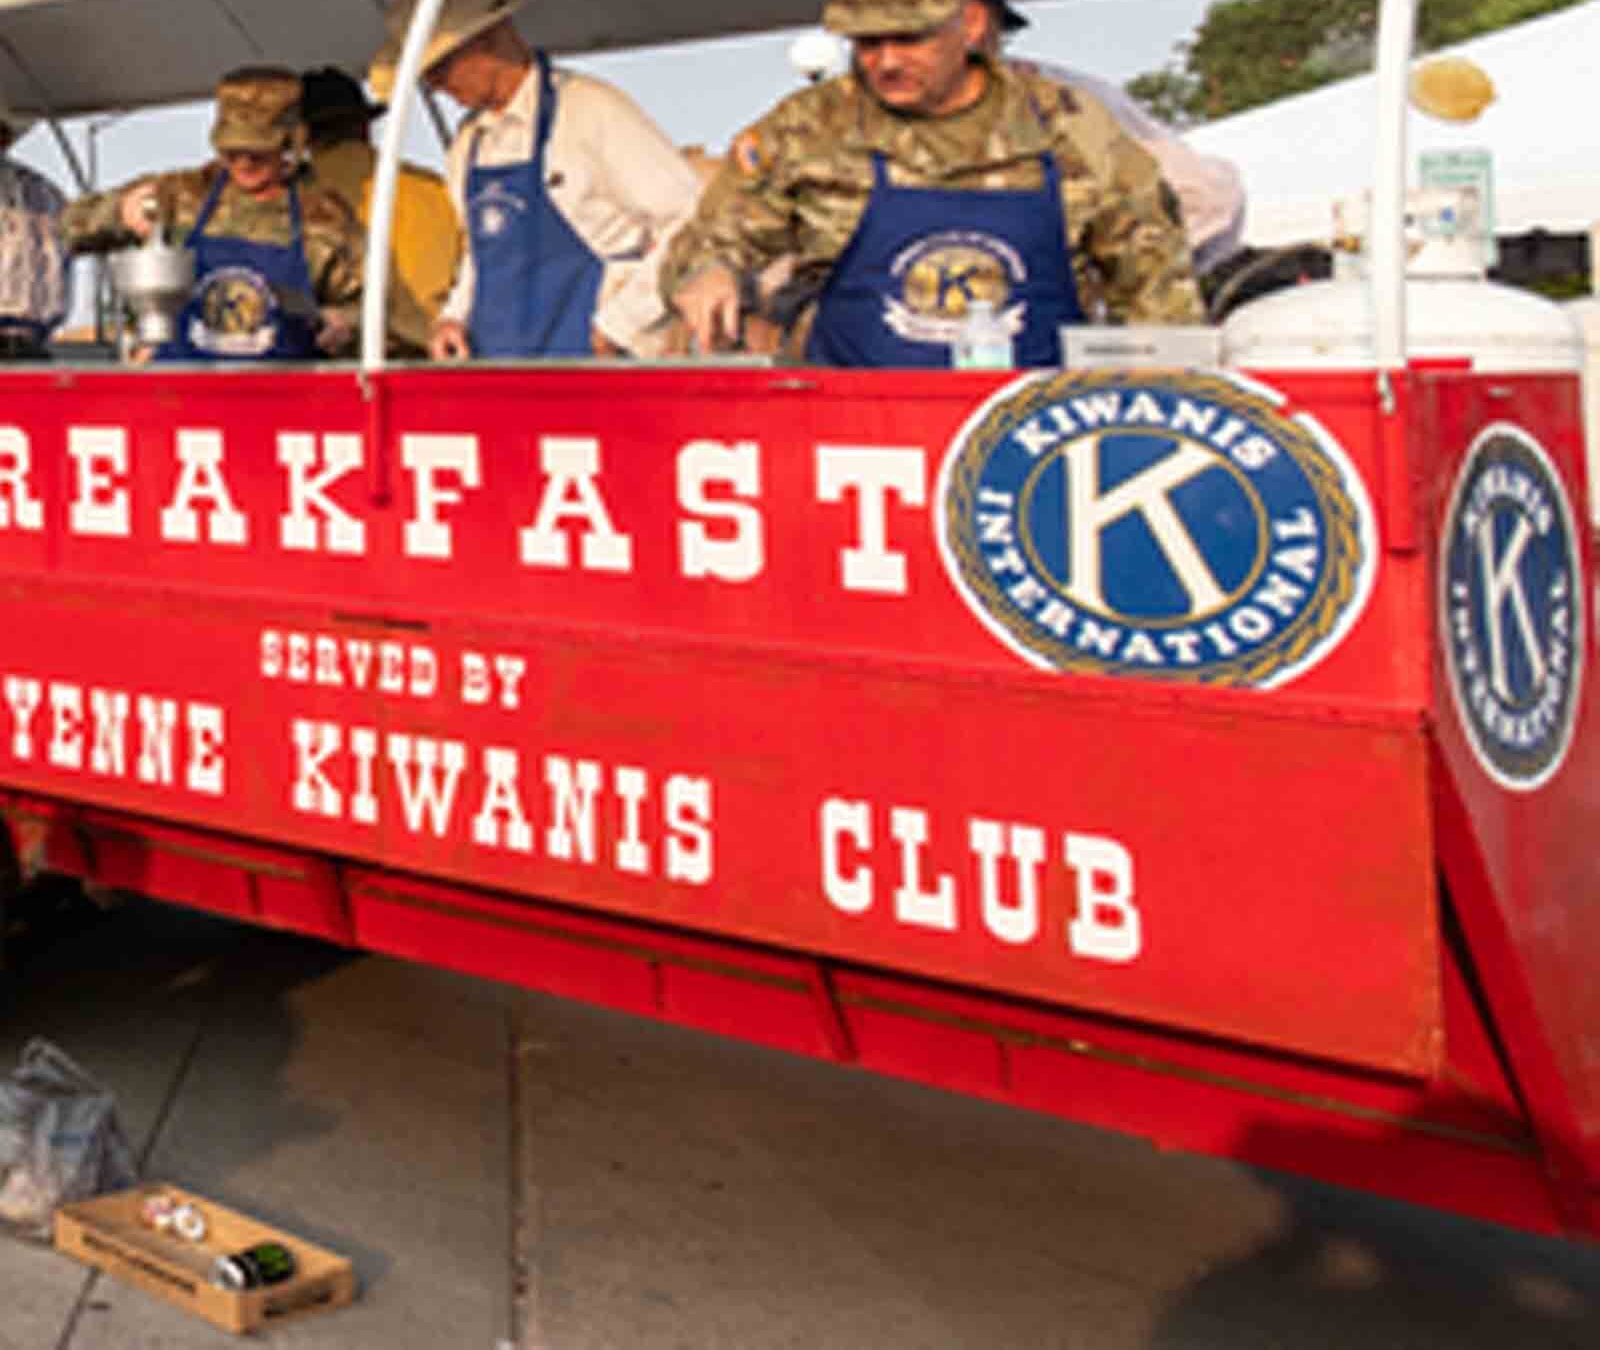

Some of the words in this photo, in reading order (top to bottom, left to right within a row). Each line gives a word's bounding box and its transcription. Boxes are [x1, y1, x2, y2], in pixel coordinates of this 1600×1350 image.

[1011, 391, 1278, 469] KIWANIS
[976, 487, 1319, 664] INTERNATIONAL
[1061, 433, 1232, 618] K
[1479, 513, 1547, 706] K
[260, 630, 438, 698] SERVED
[461, 652, 527, 710] BY
[292, 718, 713, 885] KIWANIS
[820, 797, 1142, 963] CLUB
